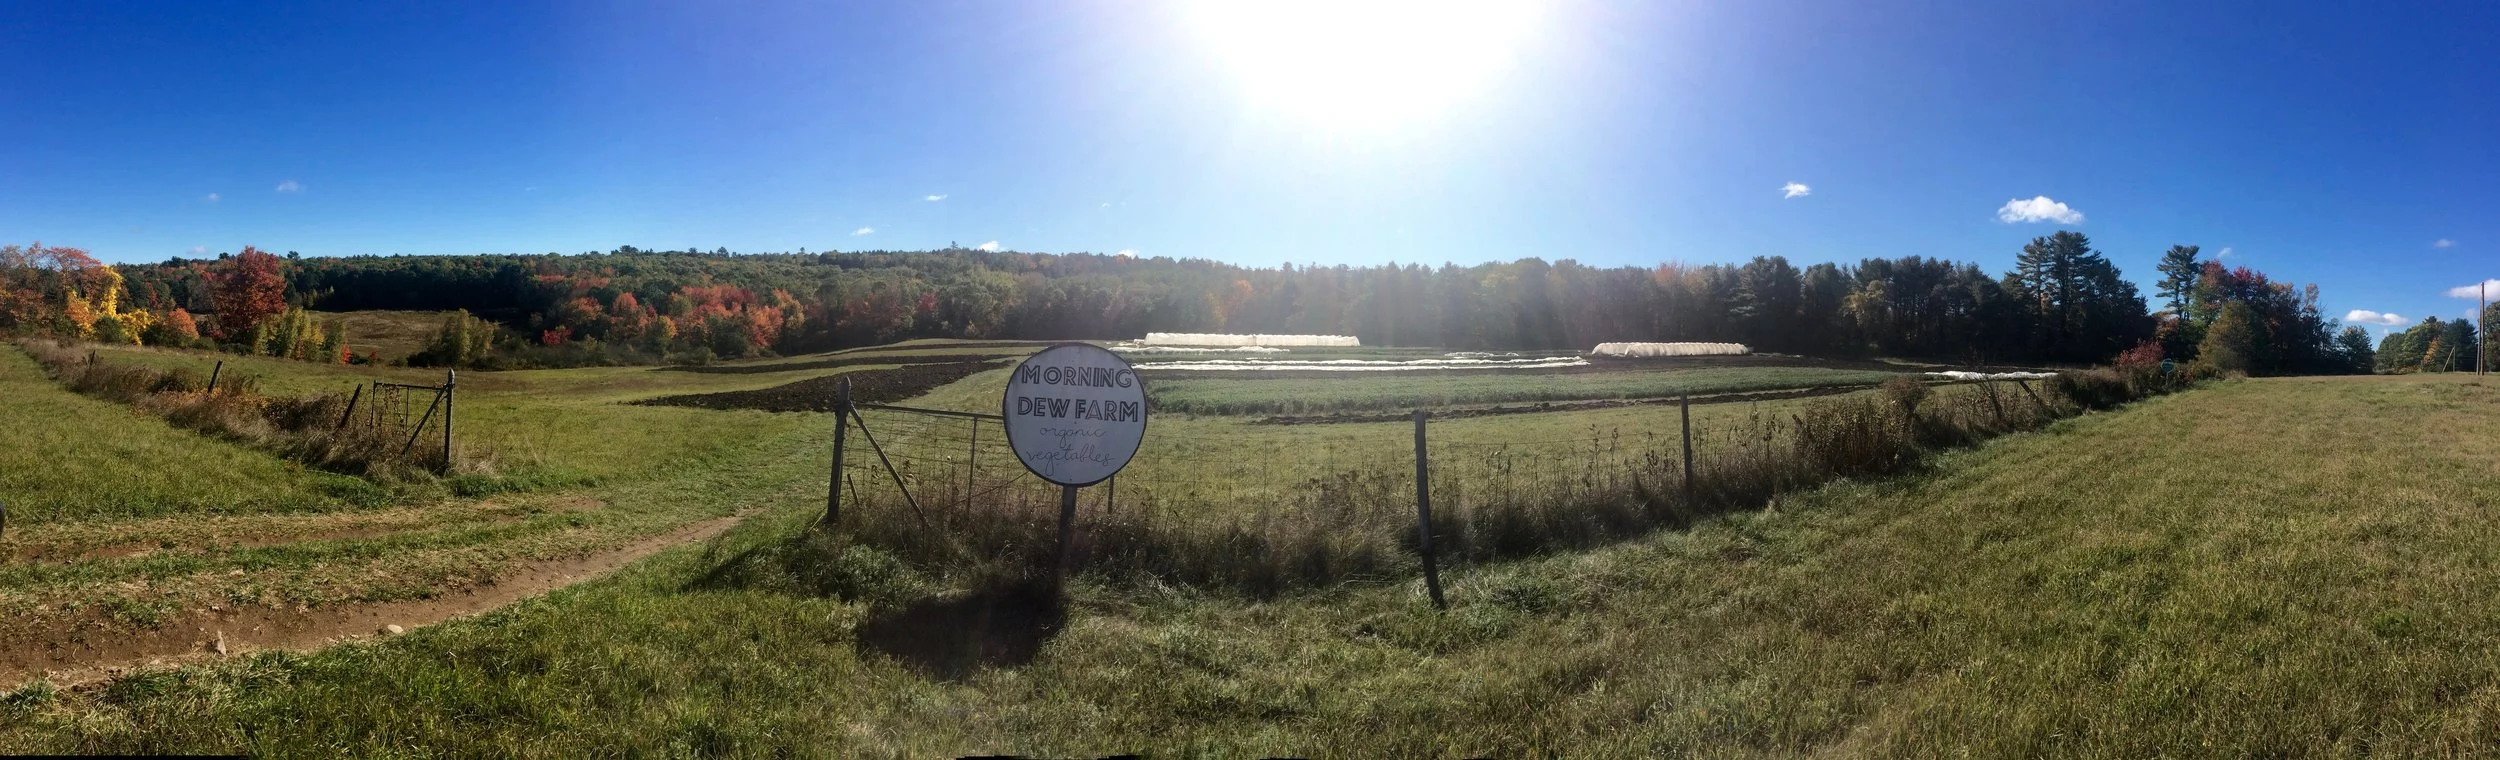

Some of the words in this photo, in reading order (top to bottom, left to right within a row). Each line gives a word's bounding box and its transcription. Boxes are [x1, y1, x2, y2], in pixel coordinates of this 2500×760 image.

[1021, 364, 1132, 388] MORNING
[1017, 396, 1070, 418] DEW
[1074, 399, 1139, 422] FARM
[1039, 427, 1106, 449] organic
[1025, 443, 1116, 477] vegetables
